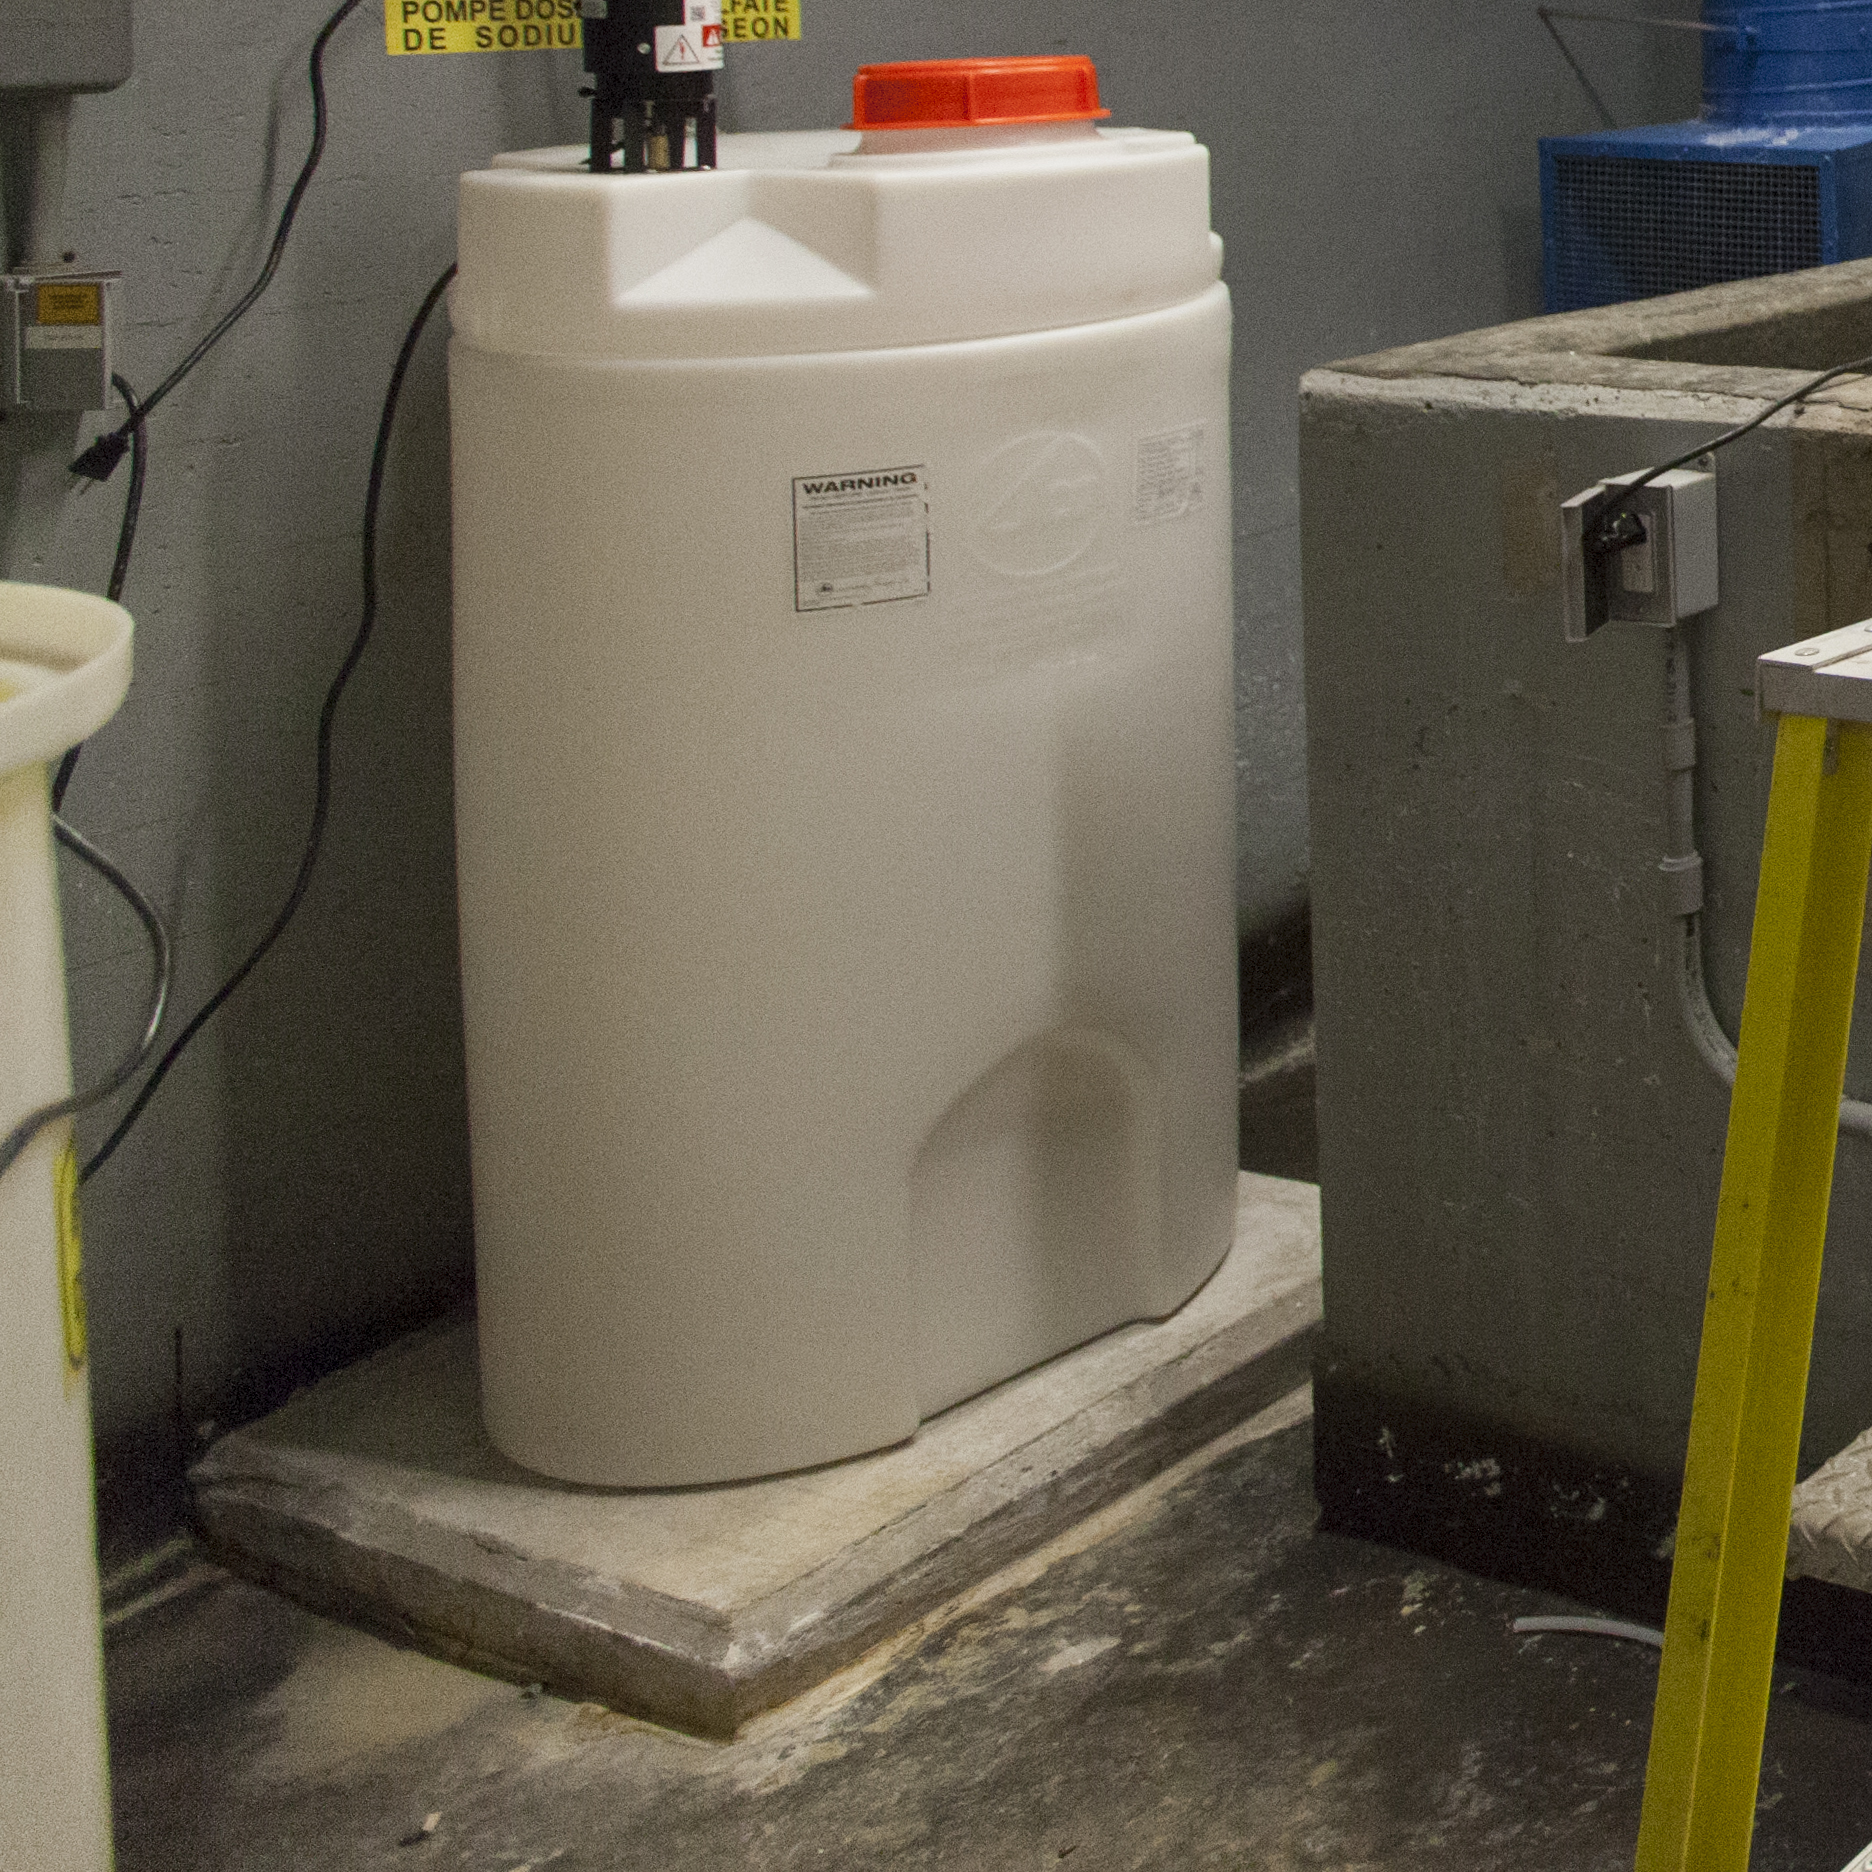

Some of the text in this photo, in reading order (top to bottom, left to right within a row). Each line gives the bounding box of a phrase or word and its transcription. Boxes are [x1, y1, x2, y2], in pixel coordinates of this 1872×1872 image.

[403, 28, 446, 51] DE
[475, 24, 575, 48] SODIU
[803, 472, 918, 494] WARNING
